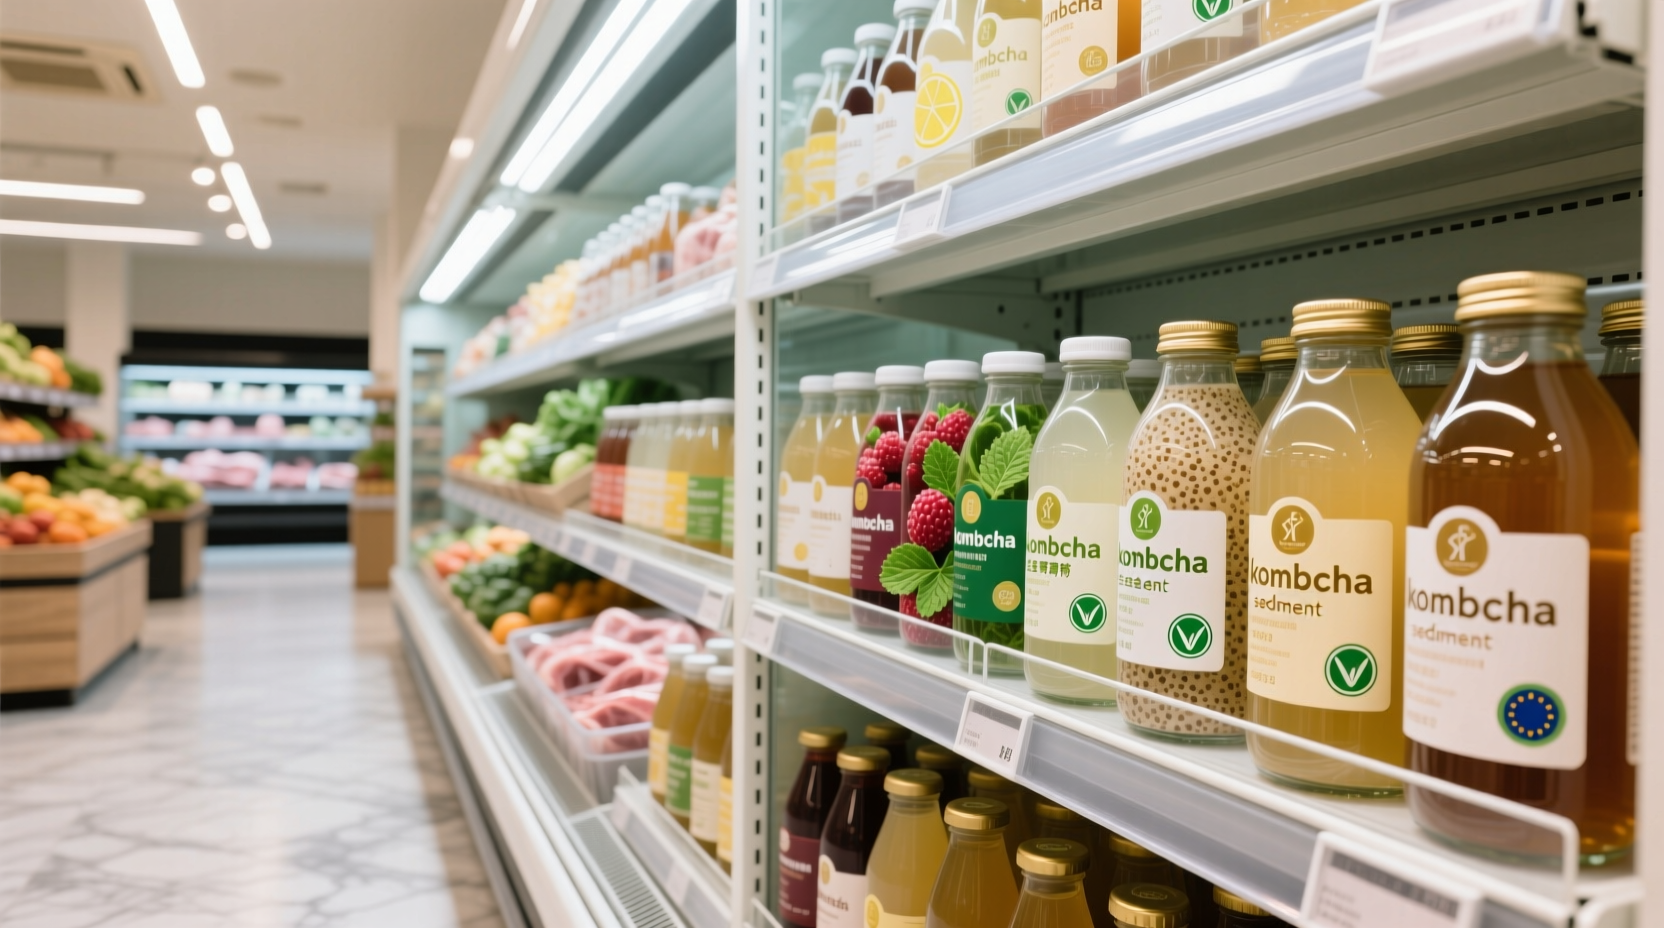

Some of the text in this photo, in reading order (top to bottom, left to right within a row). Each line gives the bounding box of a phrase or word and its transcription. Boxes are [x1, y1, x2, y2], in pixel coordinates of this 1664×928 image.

[1043, 0, 1103, 27] ombcha
[1250, 557, 1373, 595] kombcha
[1408, 577, 1557, 627] kombcha
